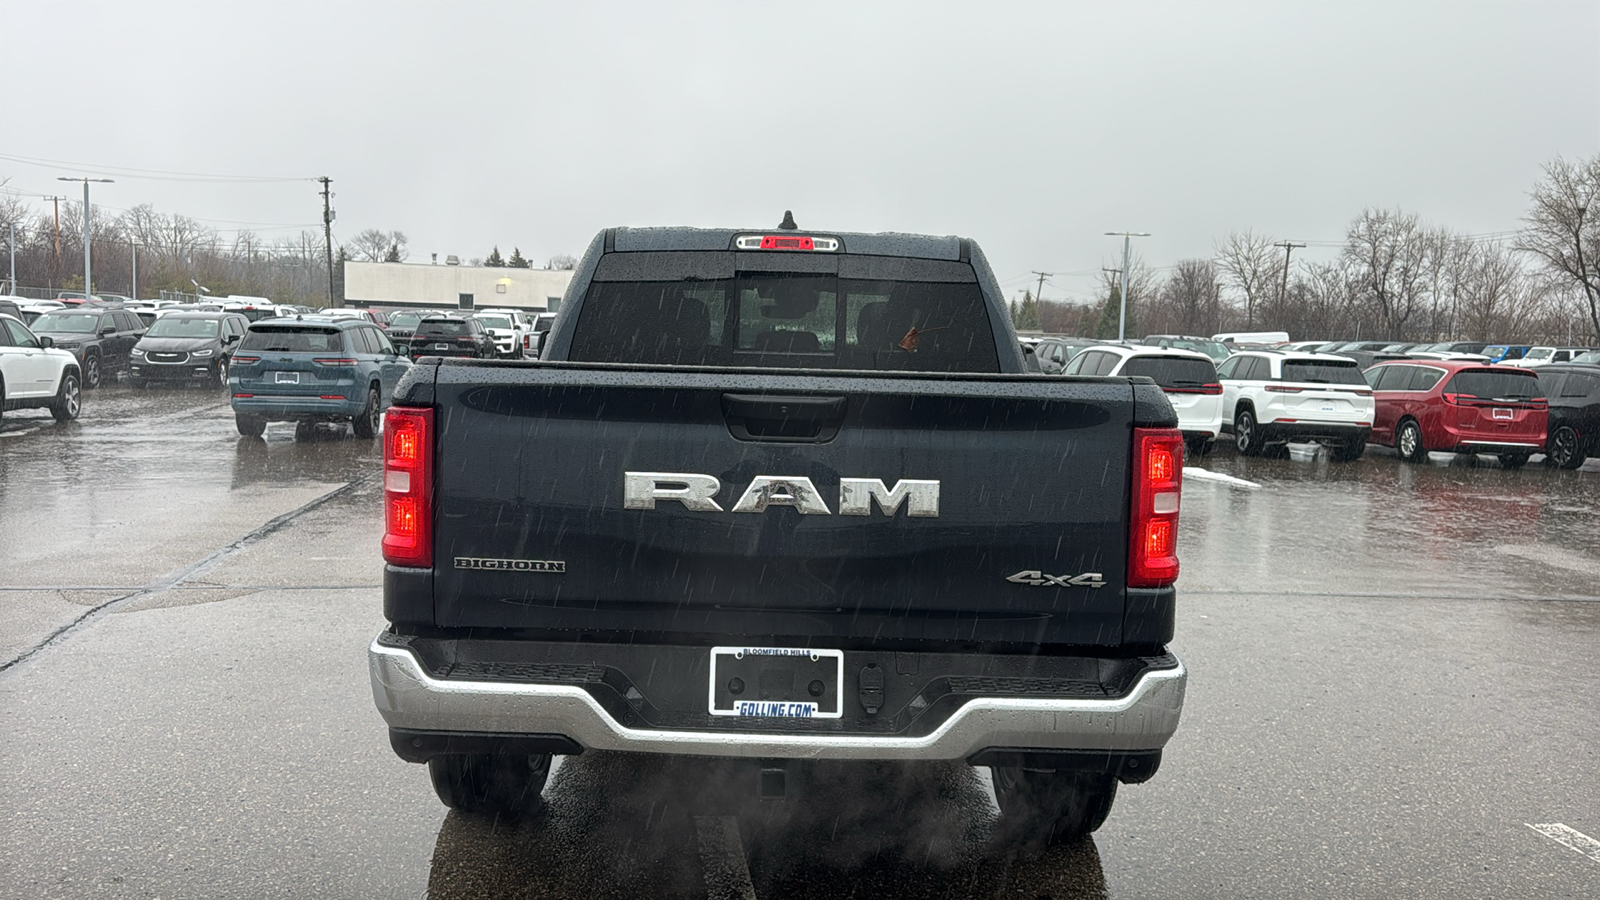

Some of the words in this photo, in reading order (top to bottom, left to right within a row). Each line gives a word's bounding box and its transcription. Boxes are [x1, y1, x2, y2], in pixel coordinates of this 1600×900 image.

[624, 471, 940, 517] RAM
[454, 557, 565, 572] BIGHORN
[743, 648, 788, 656] BLOOMFIELD
[740, 702, 812, 717] GOLLING.COM
